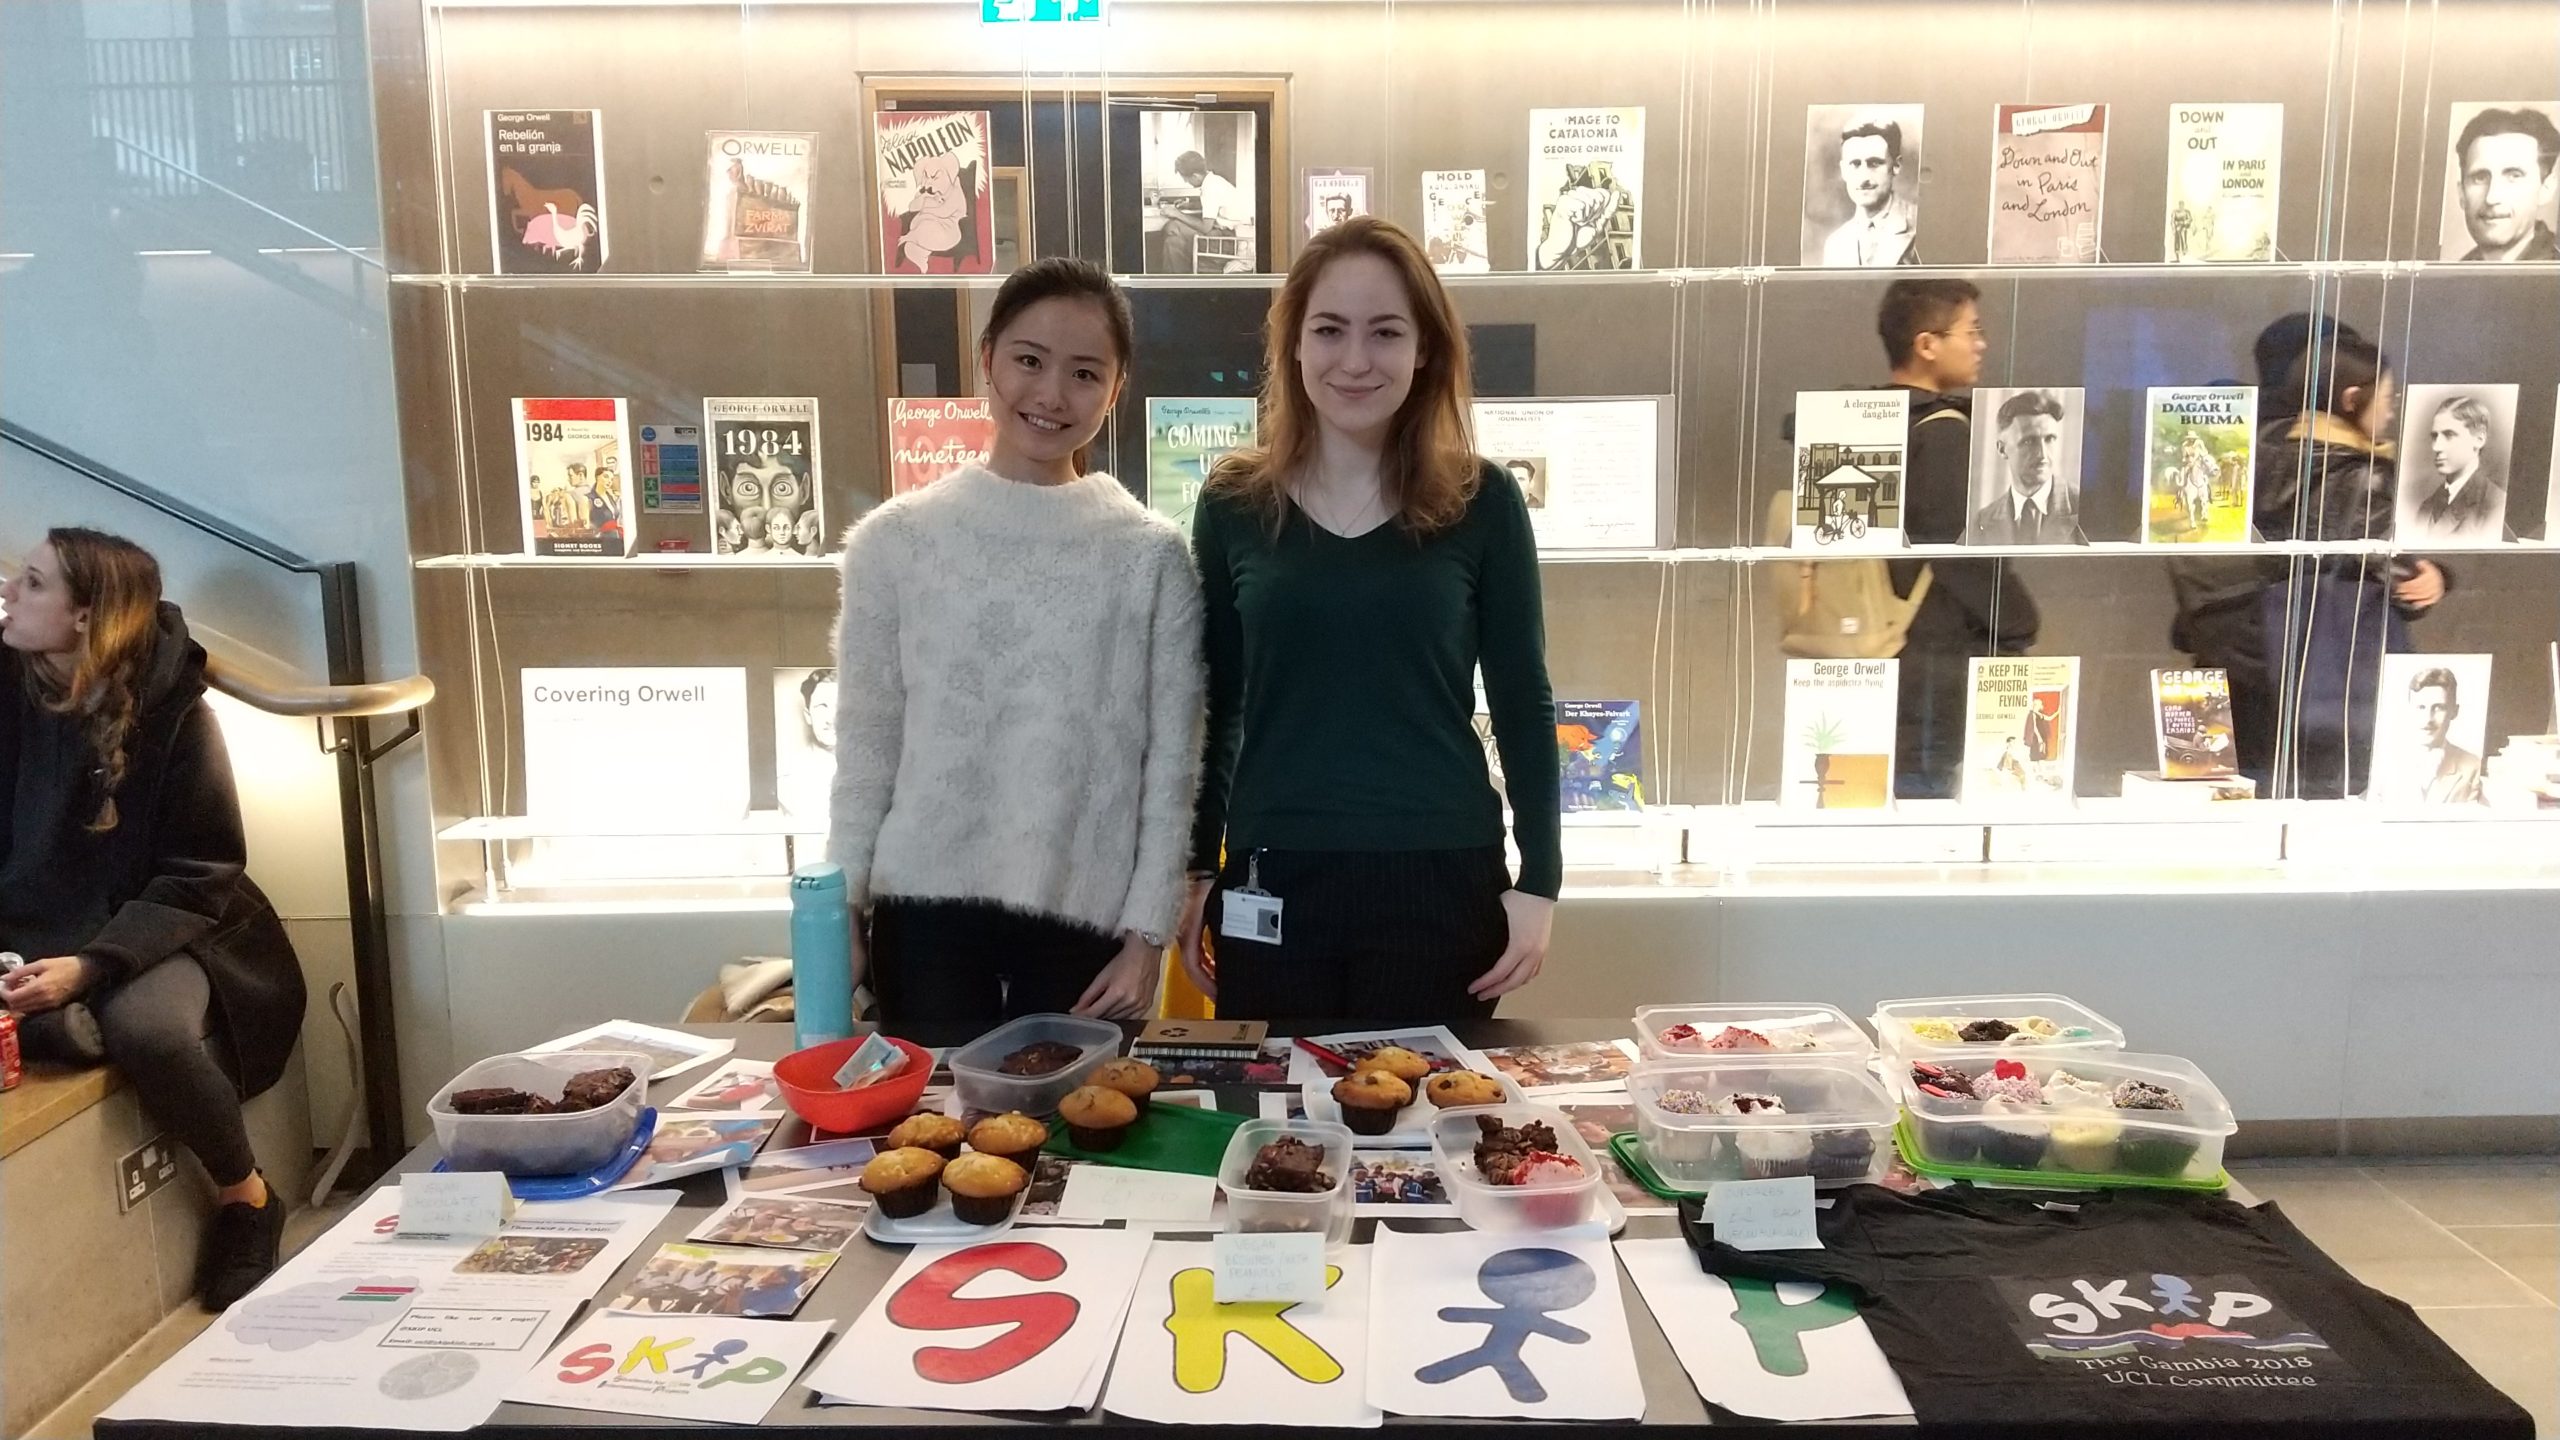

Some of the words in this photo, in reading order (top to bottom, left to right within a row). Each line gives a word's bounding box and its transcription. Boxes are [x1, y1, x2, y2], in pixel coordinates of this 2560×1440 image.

[498, 113, 524, 122] George
[526, 113, 551, 121] Orwell
[1555, 115, 1600, 125] MAGE
[1606, 115, 1621, 125] TO
[2180, 111, 2224, 123] DOWN
[498, 129, 545, 140] Rebelión
[1549, 128, 1618, 139] CATALONIA
[500, 143, 513, 152] en
[516, 142, 525, 152] la
[529, 141, 561, 154] granja
[722, 139, 803, 156] ORWELL
[1543, 145, 1582, 154] GEORGE
[1586, 144, 1623, 153] ORWELL
[2187, 137, 2218, 150] OUT
[2000, 146, 2042, 169] Down
[2044, 148, 2068, 164] and
[2070, 148, 2098, 168] Out
[2222, 159, 2235, 170] IN
[2238, 159, 2266, 170] PARIS
[1436, 172, 1472, 182] HOLD
[2017, 175, 2032, 187] in
[2038, 171, 2078, 195] Paris
[2222, 178, 2265, 189] LONDON
[2002, 194, 2029, 212] and
[2027, 198, 2091, 222] London
[2171, 392, 2207, 401] George
[2208, 392, 2245, 401] Orwell
[713, 404, 759, 413] GEORGE
[763, 404, 810, 413] ORWELL
[1843, 399, 1850, 408] A
[1852, 398, 1901, 410] clergyman's
[2162, 402, 2221, 413] DAGAR
[2225, 402, 2232, 412] I
[894, 399, 942, 428] George
[944, 400, 993, 421] Orwell
[1862, 410, 1901, 419] daughter
[2180, 415, 2245, 425] BURMA
[525, 423, 564, 442] 1984
[1167, 424, 1238, 448] COMING
[722, 429, 803, 456] 1984
[895, 438, 990, 464] nineteen
[1814, 662, 1849, 678] George
[1854, 662, 1886, 675] Orwell
[1988, 664, 2010, 677] KEEP
[2013, 664, 2029, 677] THE
[1793, 678, 1811, 688] Keep
[1813, 678, 1824, 687] the
[2162, 670, 2225, 684] GEORGE
[1977, 679, 2028, 693] ASPIDISTRA
[534, 685, 630, 706] Covering
[637, 685, 706, 702] Orwell
[1999, 695, 2028, 708] FLYING
[884, 1241, 1082, 1386] S
[2075, 1355, 2132, 1371] The
[2138, 1355, 2242, 1374] Gambia
[2243, 1355, 2313, 1371] 2018
[2102, 1371, 2163, 1387] UCL
[2168, 1374, 2318, 1388] Committee
